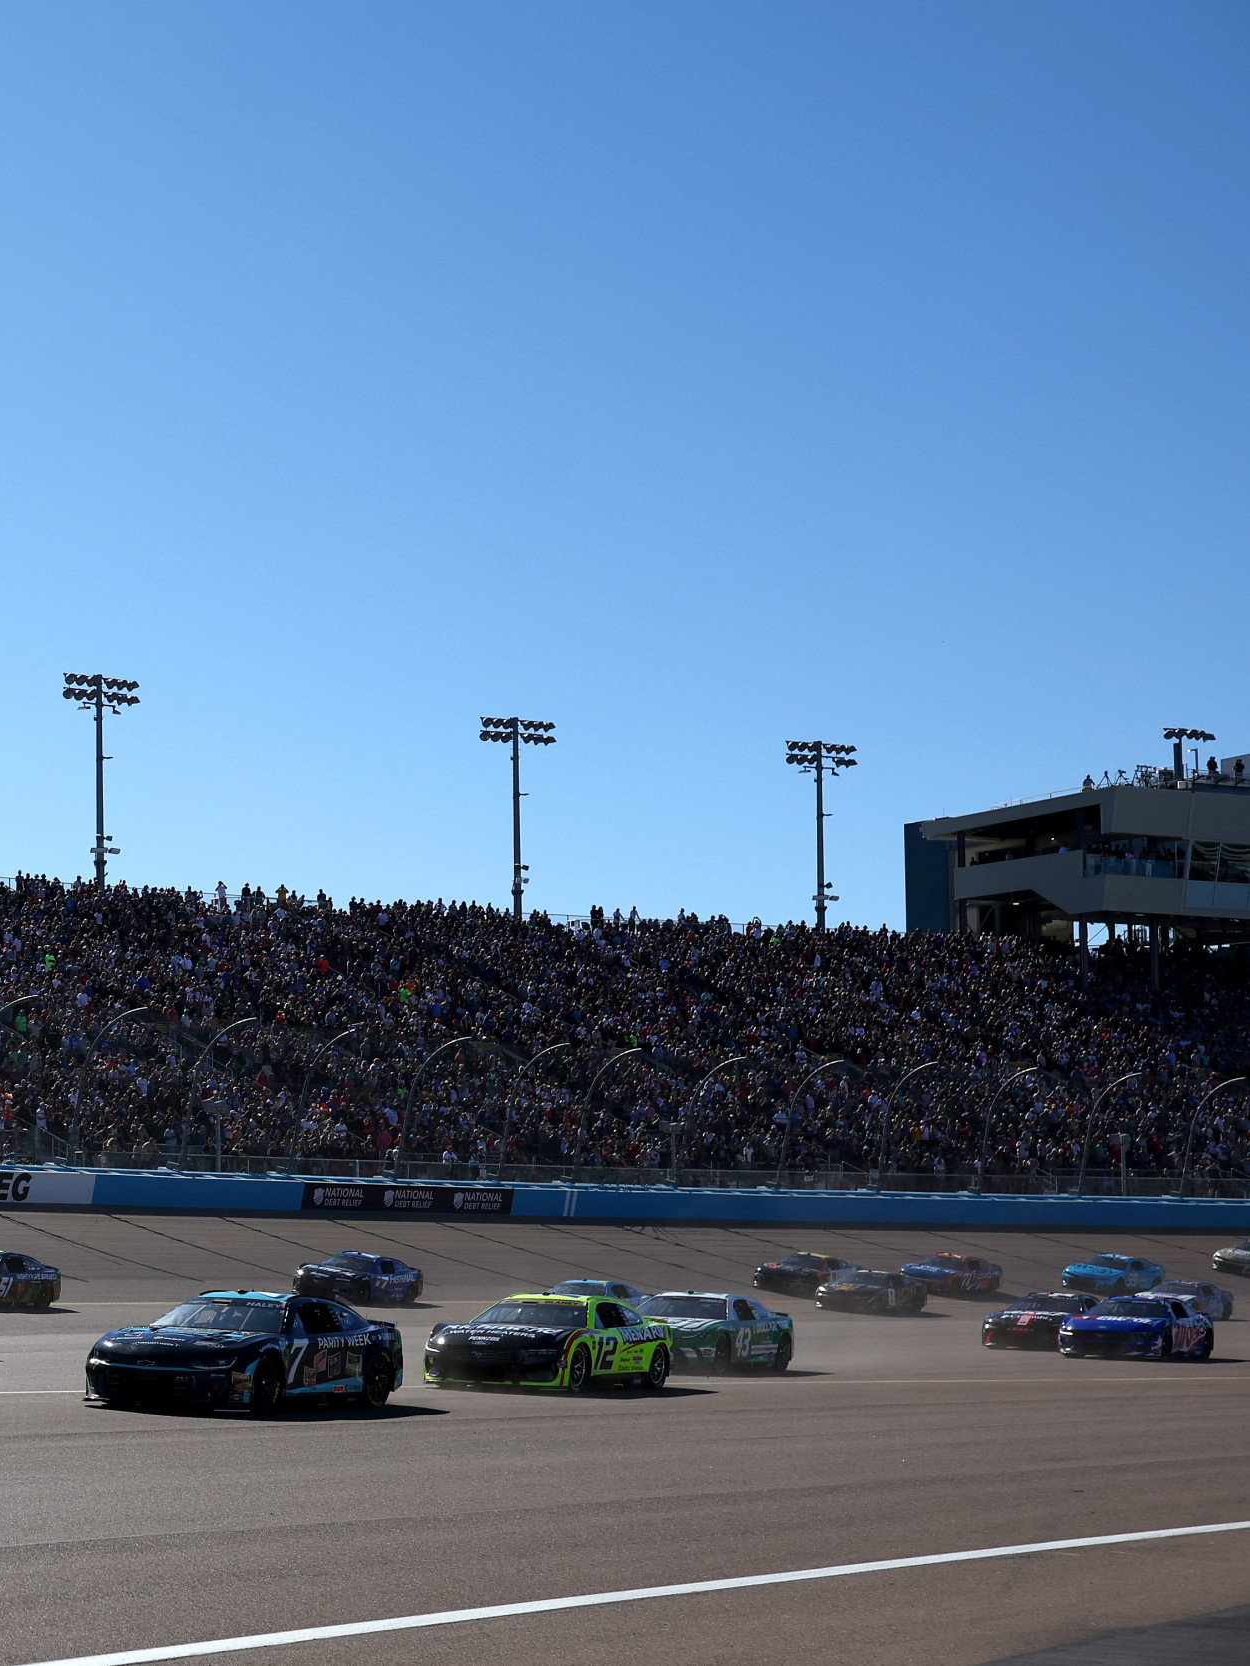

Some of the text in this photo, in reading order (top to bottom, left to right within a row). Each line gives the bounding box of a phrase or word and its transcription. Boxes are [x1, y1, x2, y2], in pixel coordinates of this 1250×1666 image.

[325, 1187, 364, 1199] NATIONAL
[394, 1189, 434, 1201] NATIONAL
[464, 1191, 502, 1203] NATIONAL
[324, 1198, 362, 1207] DEBT RELIEF
[394, 1200, 432, 1209] DEBT RELIEF
[464, 1202, 501, 1211] DEBT RELIEF
[1127, 1273, 1138, 1288] 99
[246, 1301, 282, 1309] HALEY
[449, 1328, 484, 1336] WATER
[487, 1329, 537, 1339] HEATERS
[735, 1326, 752, 1358] 43
[287, 1339, 309, 1385] 7
[317, 1336, 345, 1350] PARITY
[345, 1333, 372, 1347] WEEK
[594, 1335, 619, 1372] 12
